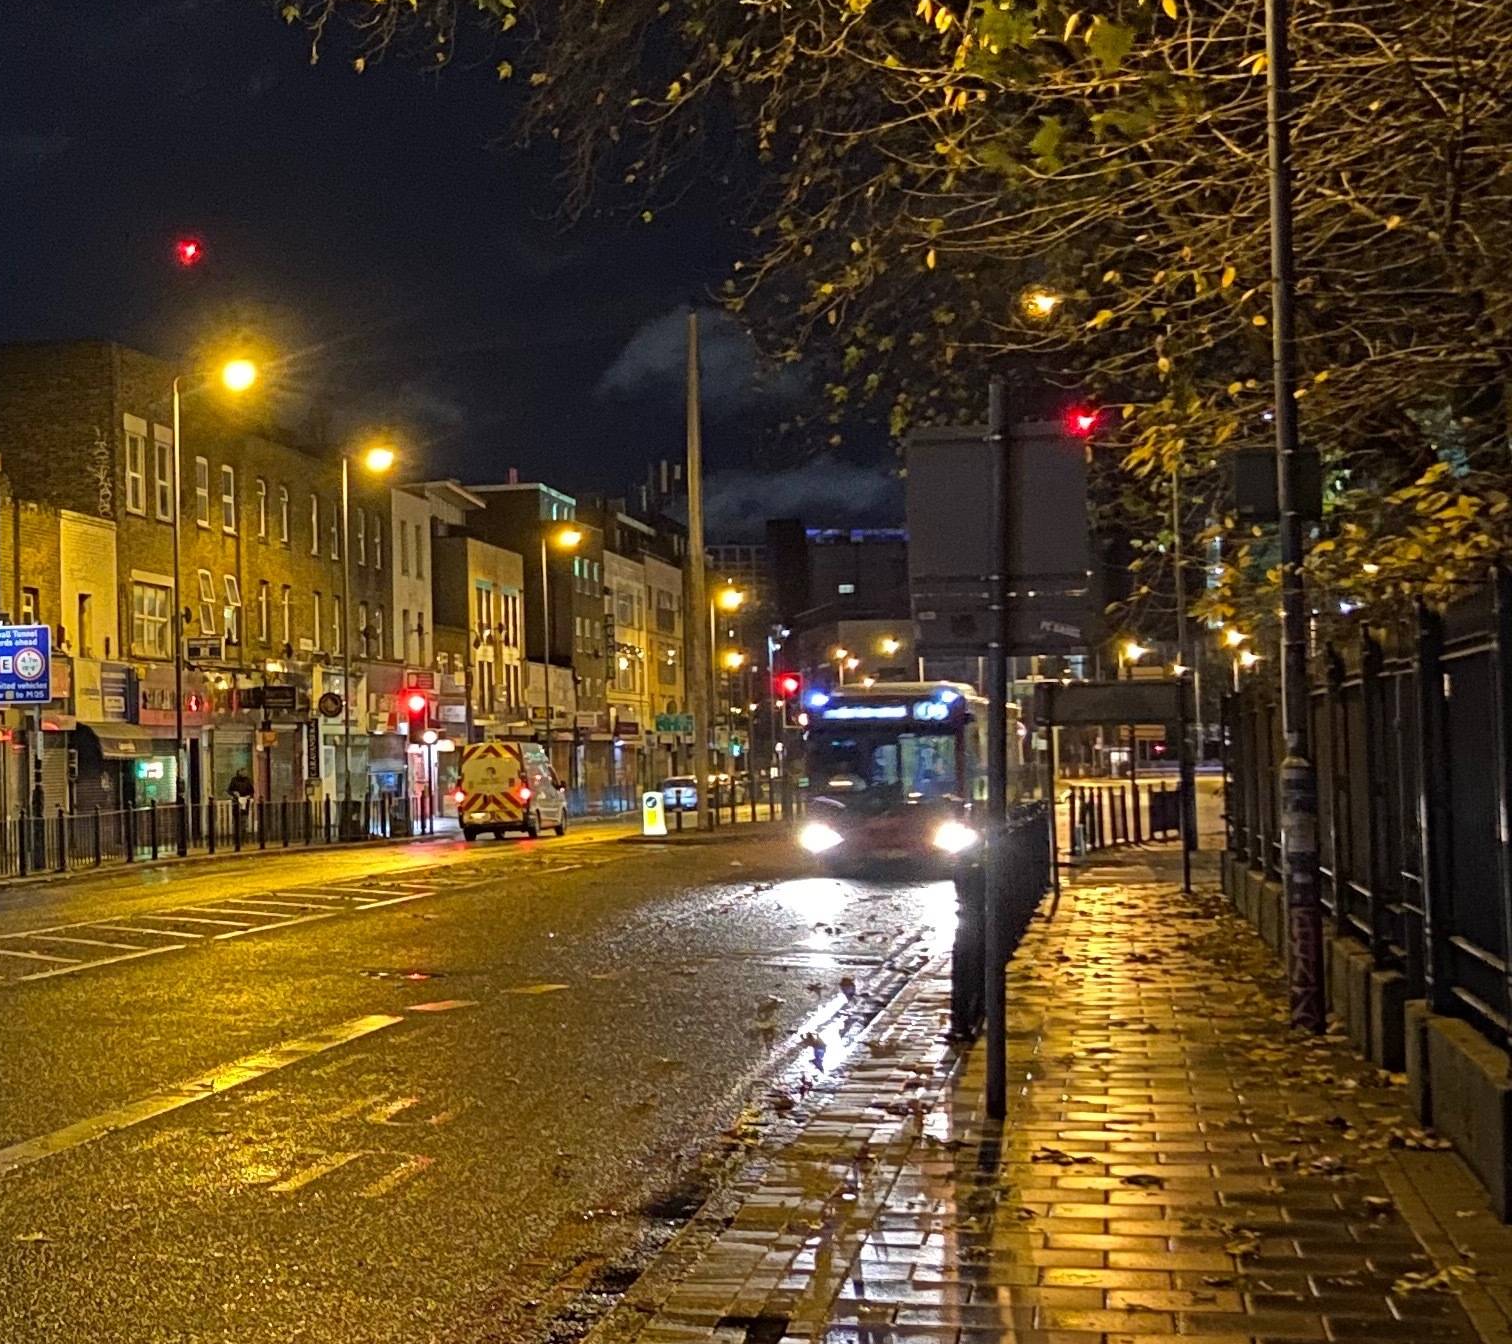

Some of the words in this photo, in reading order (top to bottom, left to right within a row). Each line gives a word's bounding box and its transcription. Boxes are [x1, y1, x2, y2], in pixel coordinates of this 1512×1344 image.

[13, 630, 38, 638] Tunnel
[15, 638, 38, 646] ahead
[2, 659, 9, 670] E
